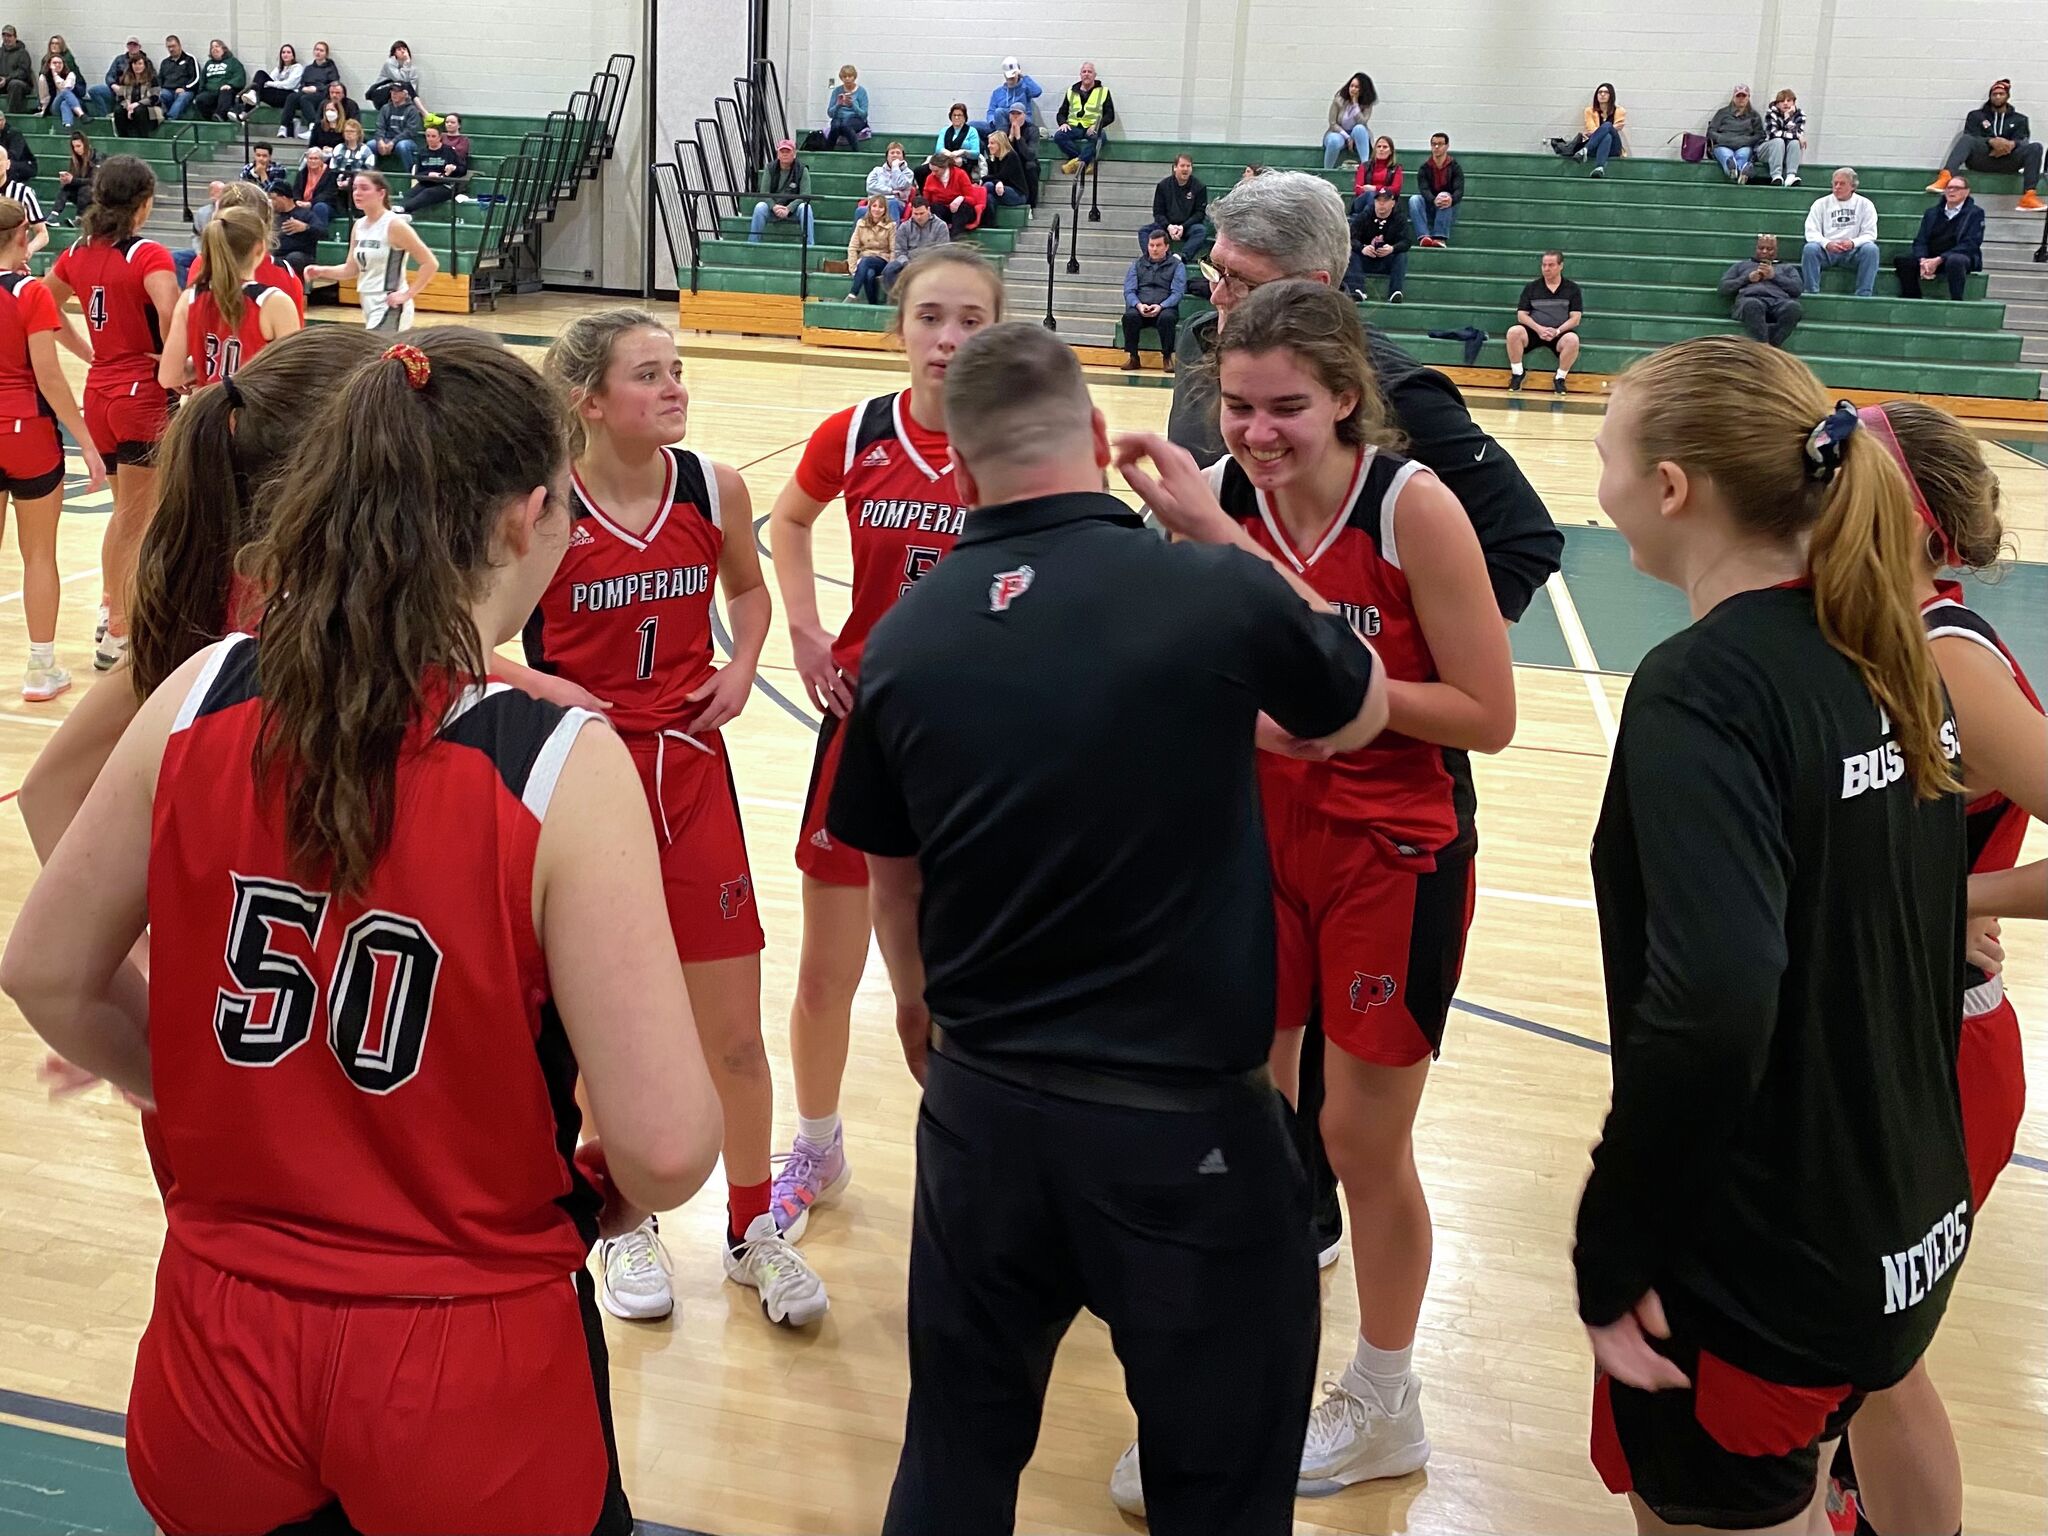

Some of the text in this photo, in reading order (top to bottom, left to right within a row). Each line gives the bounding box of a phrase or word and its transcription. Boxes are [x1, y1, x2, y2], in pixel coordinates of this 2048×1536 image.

[88, 285, 109, 331] 4
[204, 332, 243, 381] 30
[859, 499, 969, 536] POMPERA
[571, 564, 710, 613] POMPERAUG
[635, 615, 659, 681] 1
[212, 869, 444, 1097] 50
[1881, 1199, 1968, 1315] NEVERS
